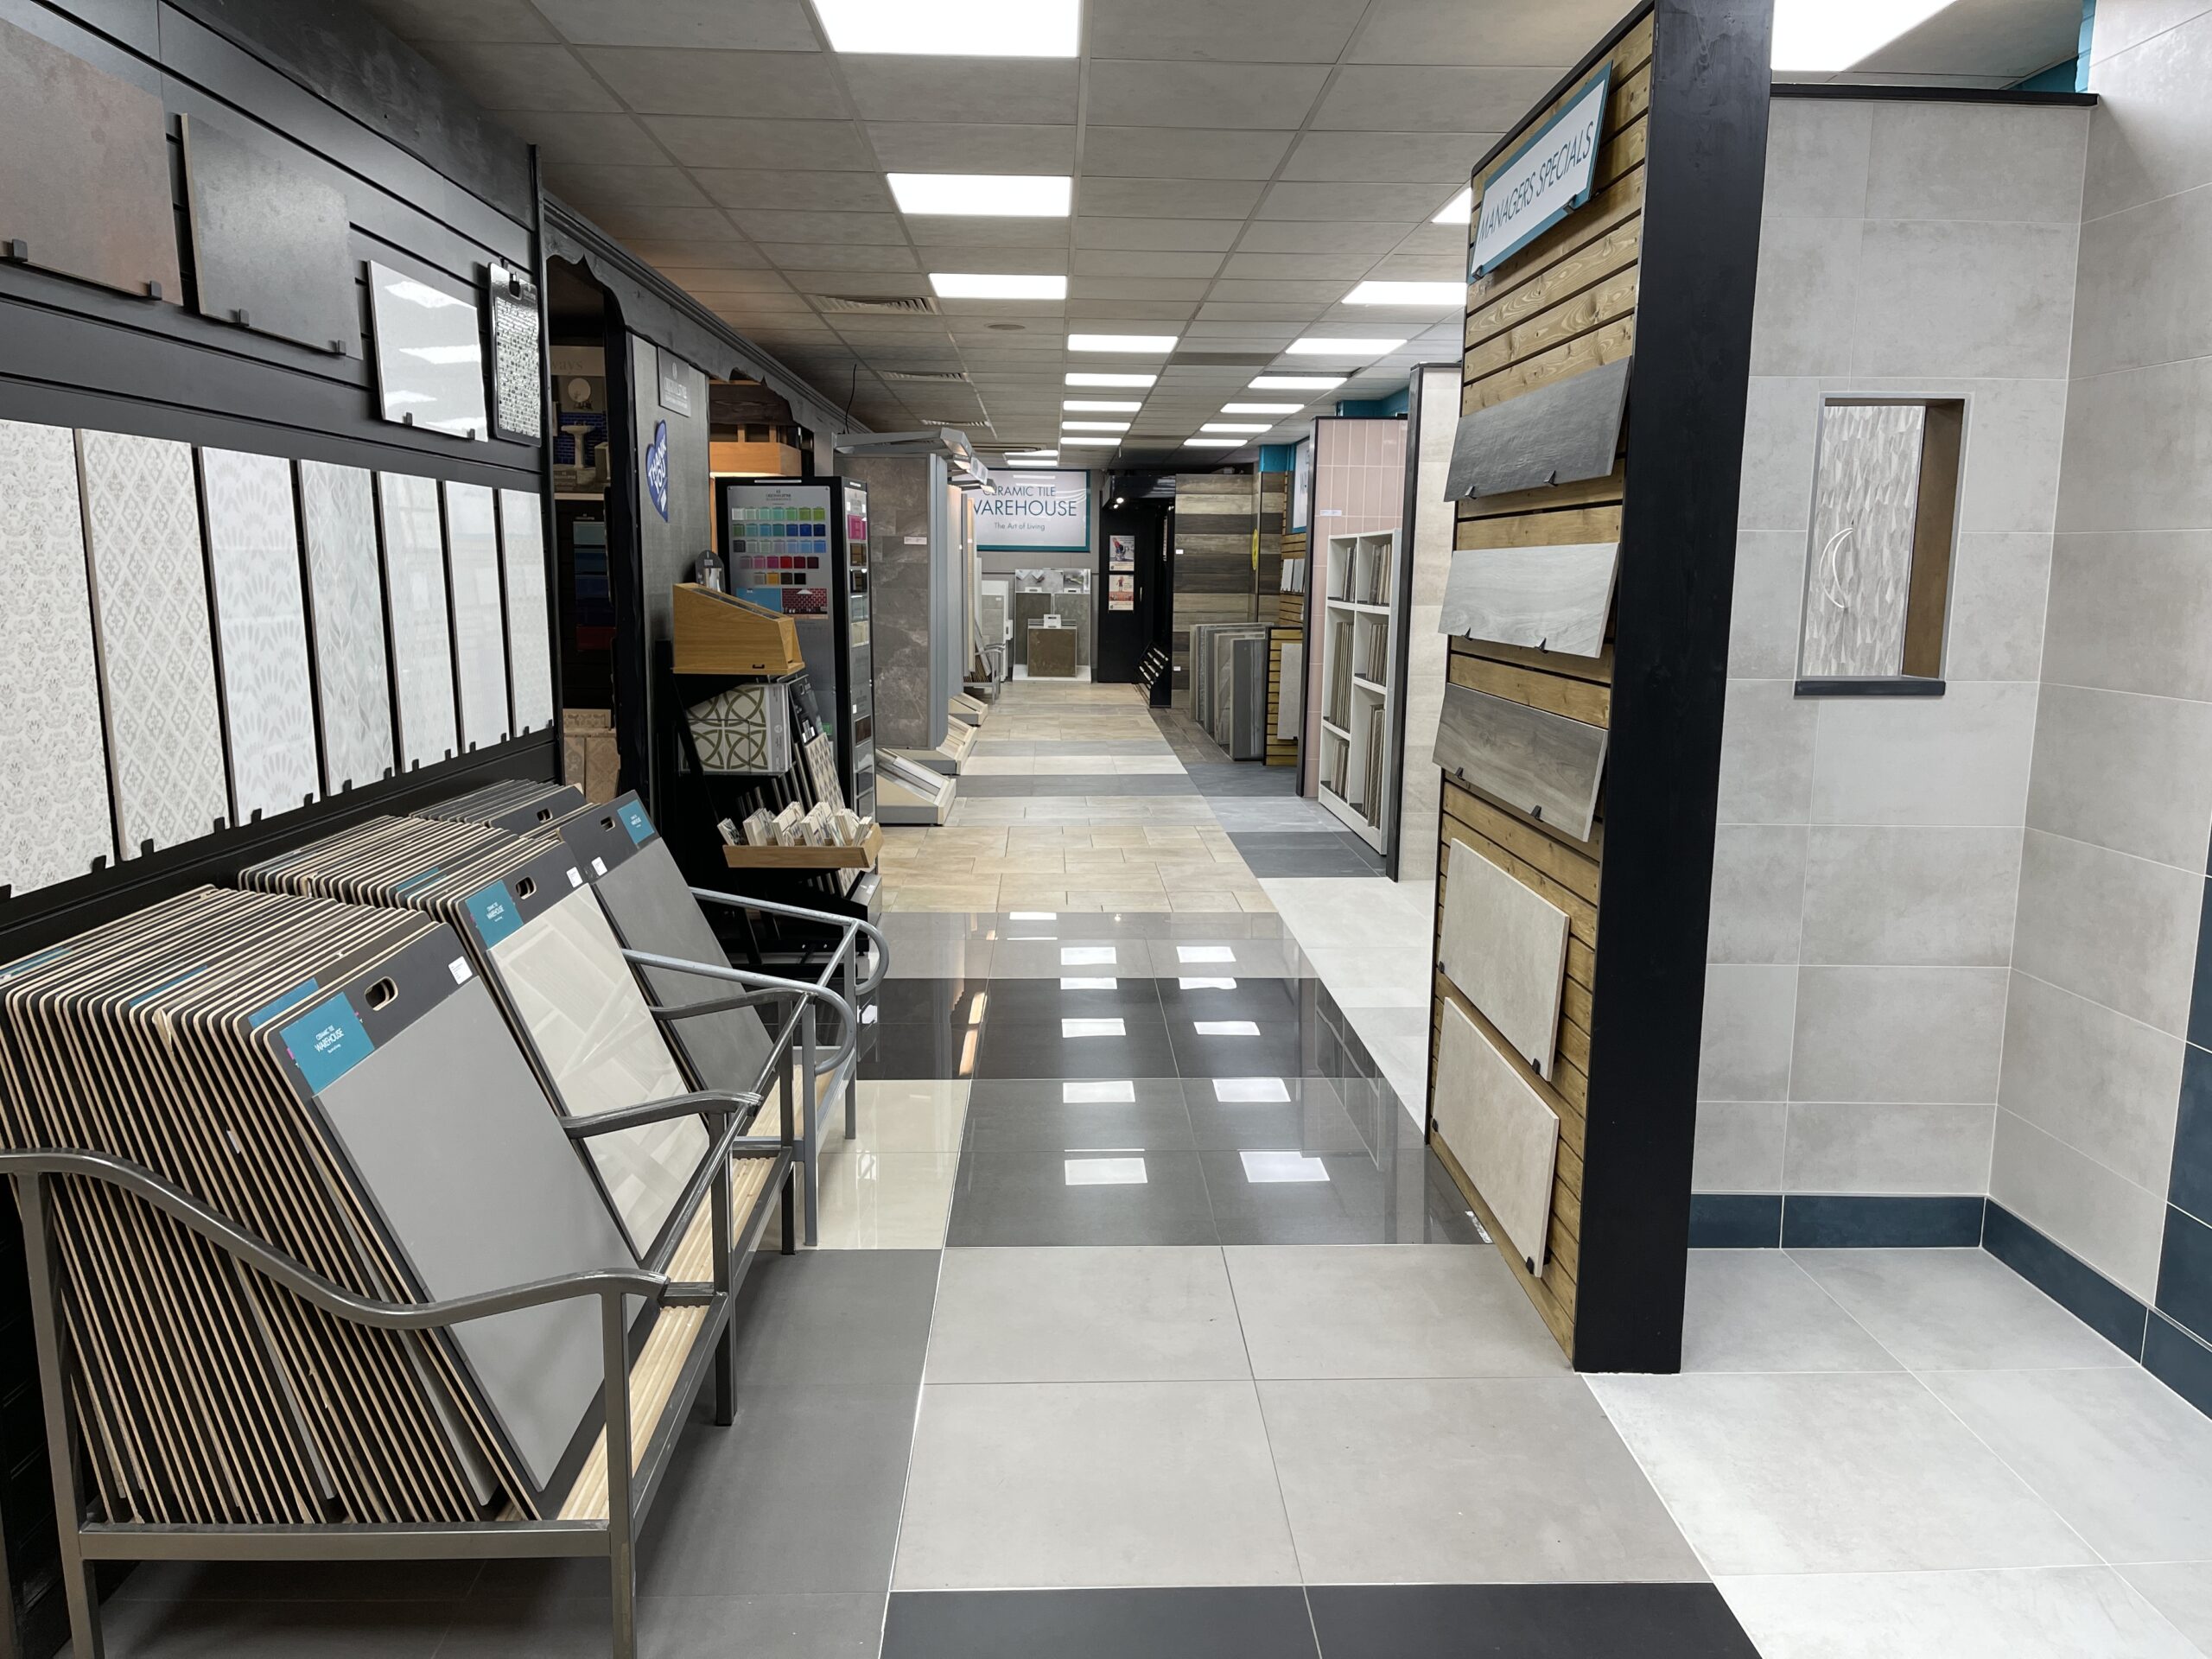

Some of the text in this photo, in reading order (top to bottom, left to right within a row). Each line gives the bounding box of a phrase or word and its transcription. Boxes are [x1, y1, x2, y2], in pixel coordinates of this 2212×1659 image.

[1478, 120, 1593, 244] MANAGERS SPECIALS
[648, 434, 666, 486] THANK
[654, 458, 666, 494] YOU
[1039, 486, 1056, 497] TILE
[1027, 522, 1046, 532] Living
[314, 1027, 345, 1052] WAREHOUSE
